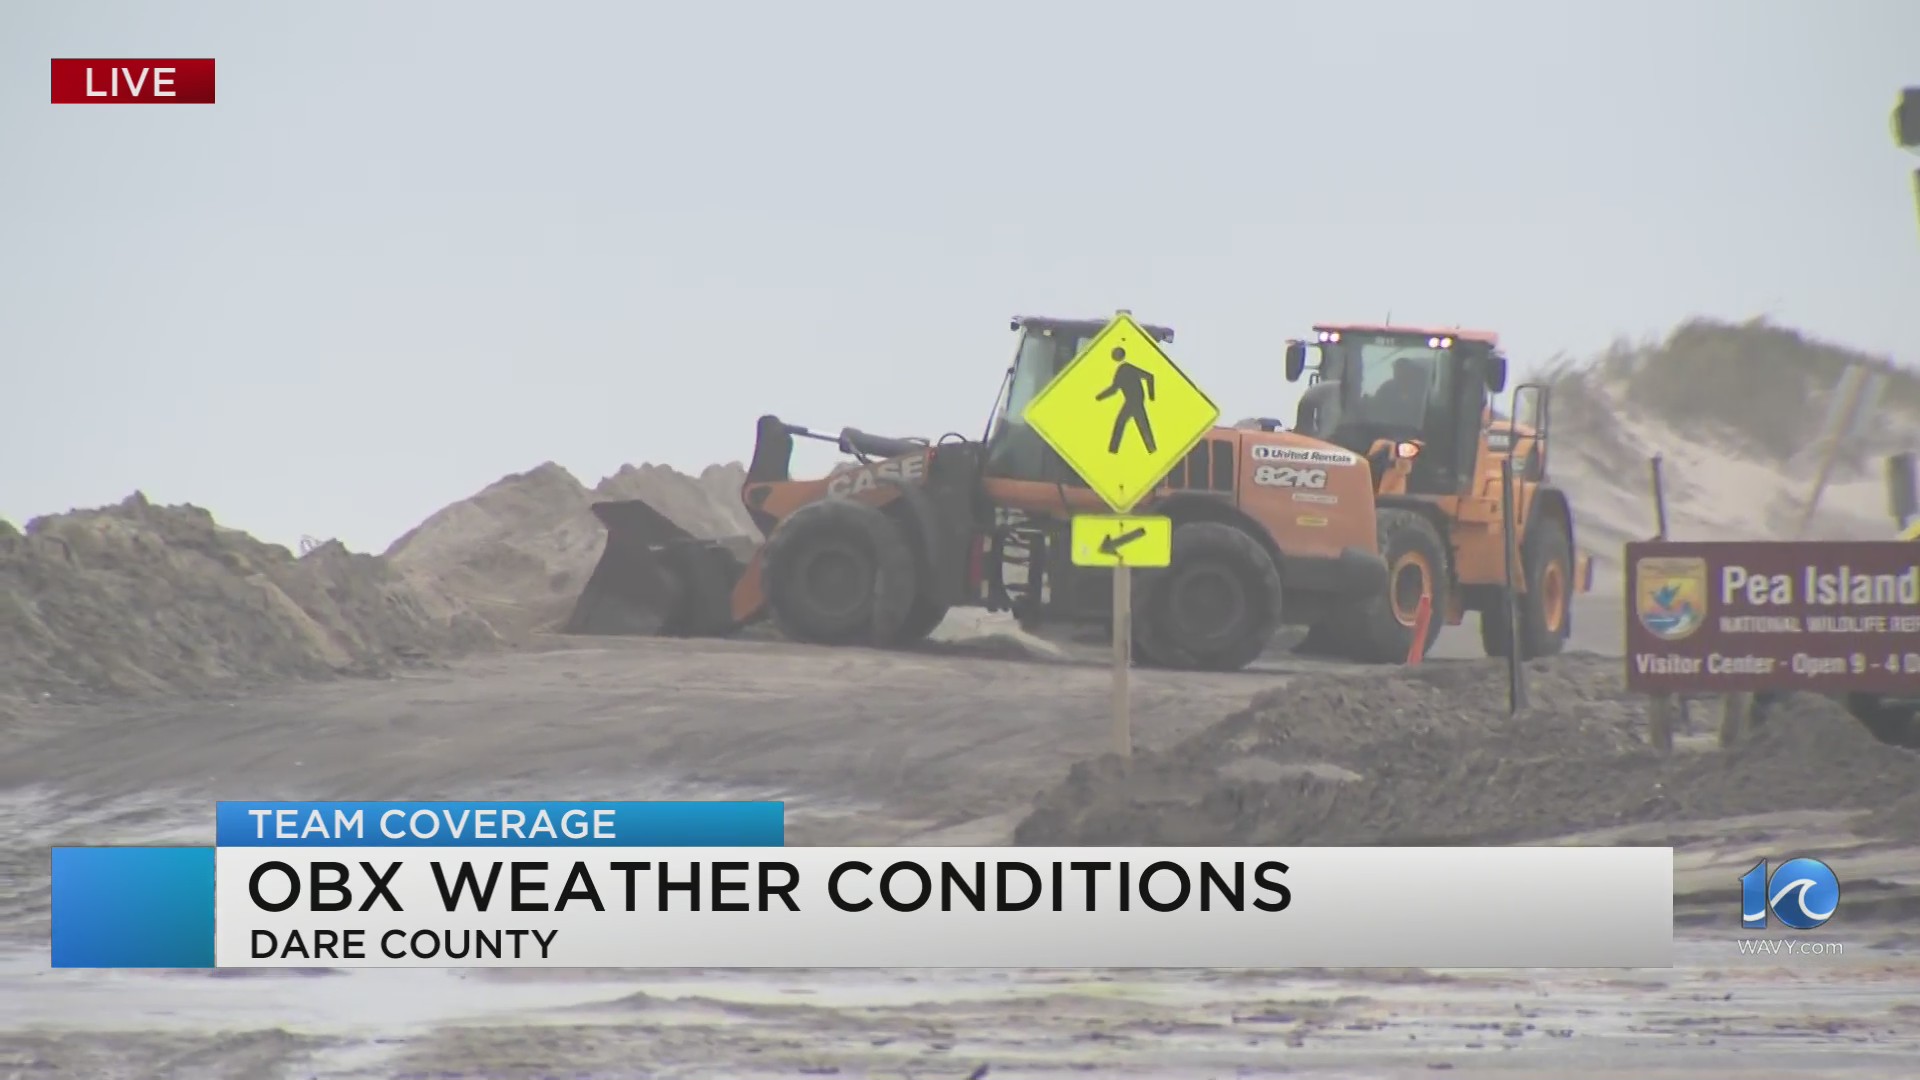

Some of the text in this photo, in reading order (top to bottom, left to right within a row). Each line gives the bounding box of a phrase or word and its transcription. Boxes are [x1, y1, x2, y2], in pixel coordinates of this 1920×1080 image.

[1271, 449, 1352, 463] United Rentals
[828, 455, 923, 500] CASE
[1255, 466, 1327, 488] 821G
[1721, 565, 1920, 605] Pea Island
[1719, 616, 1802, 632] NATIONAL
[1807, 616, 1887, 632] WILDLIFE
[1636, 653, 1702, 674] Visitor
[1707, 653, 1775, 674] Center
[1792, 653, 1847, 677] Open
[1849, 653, 1866, 674] 9
[1884, 653, 1899, 674] 4
